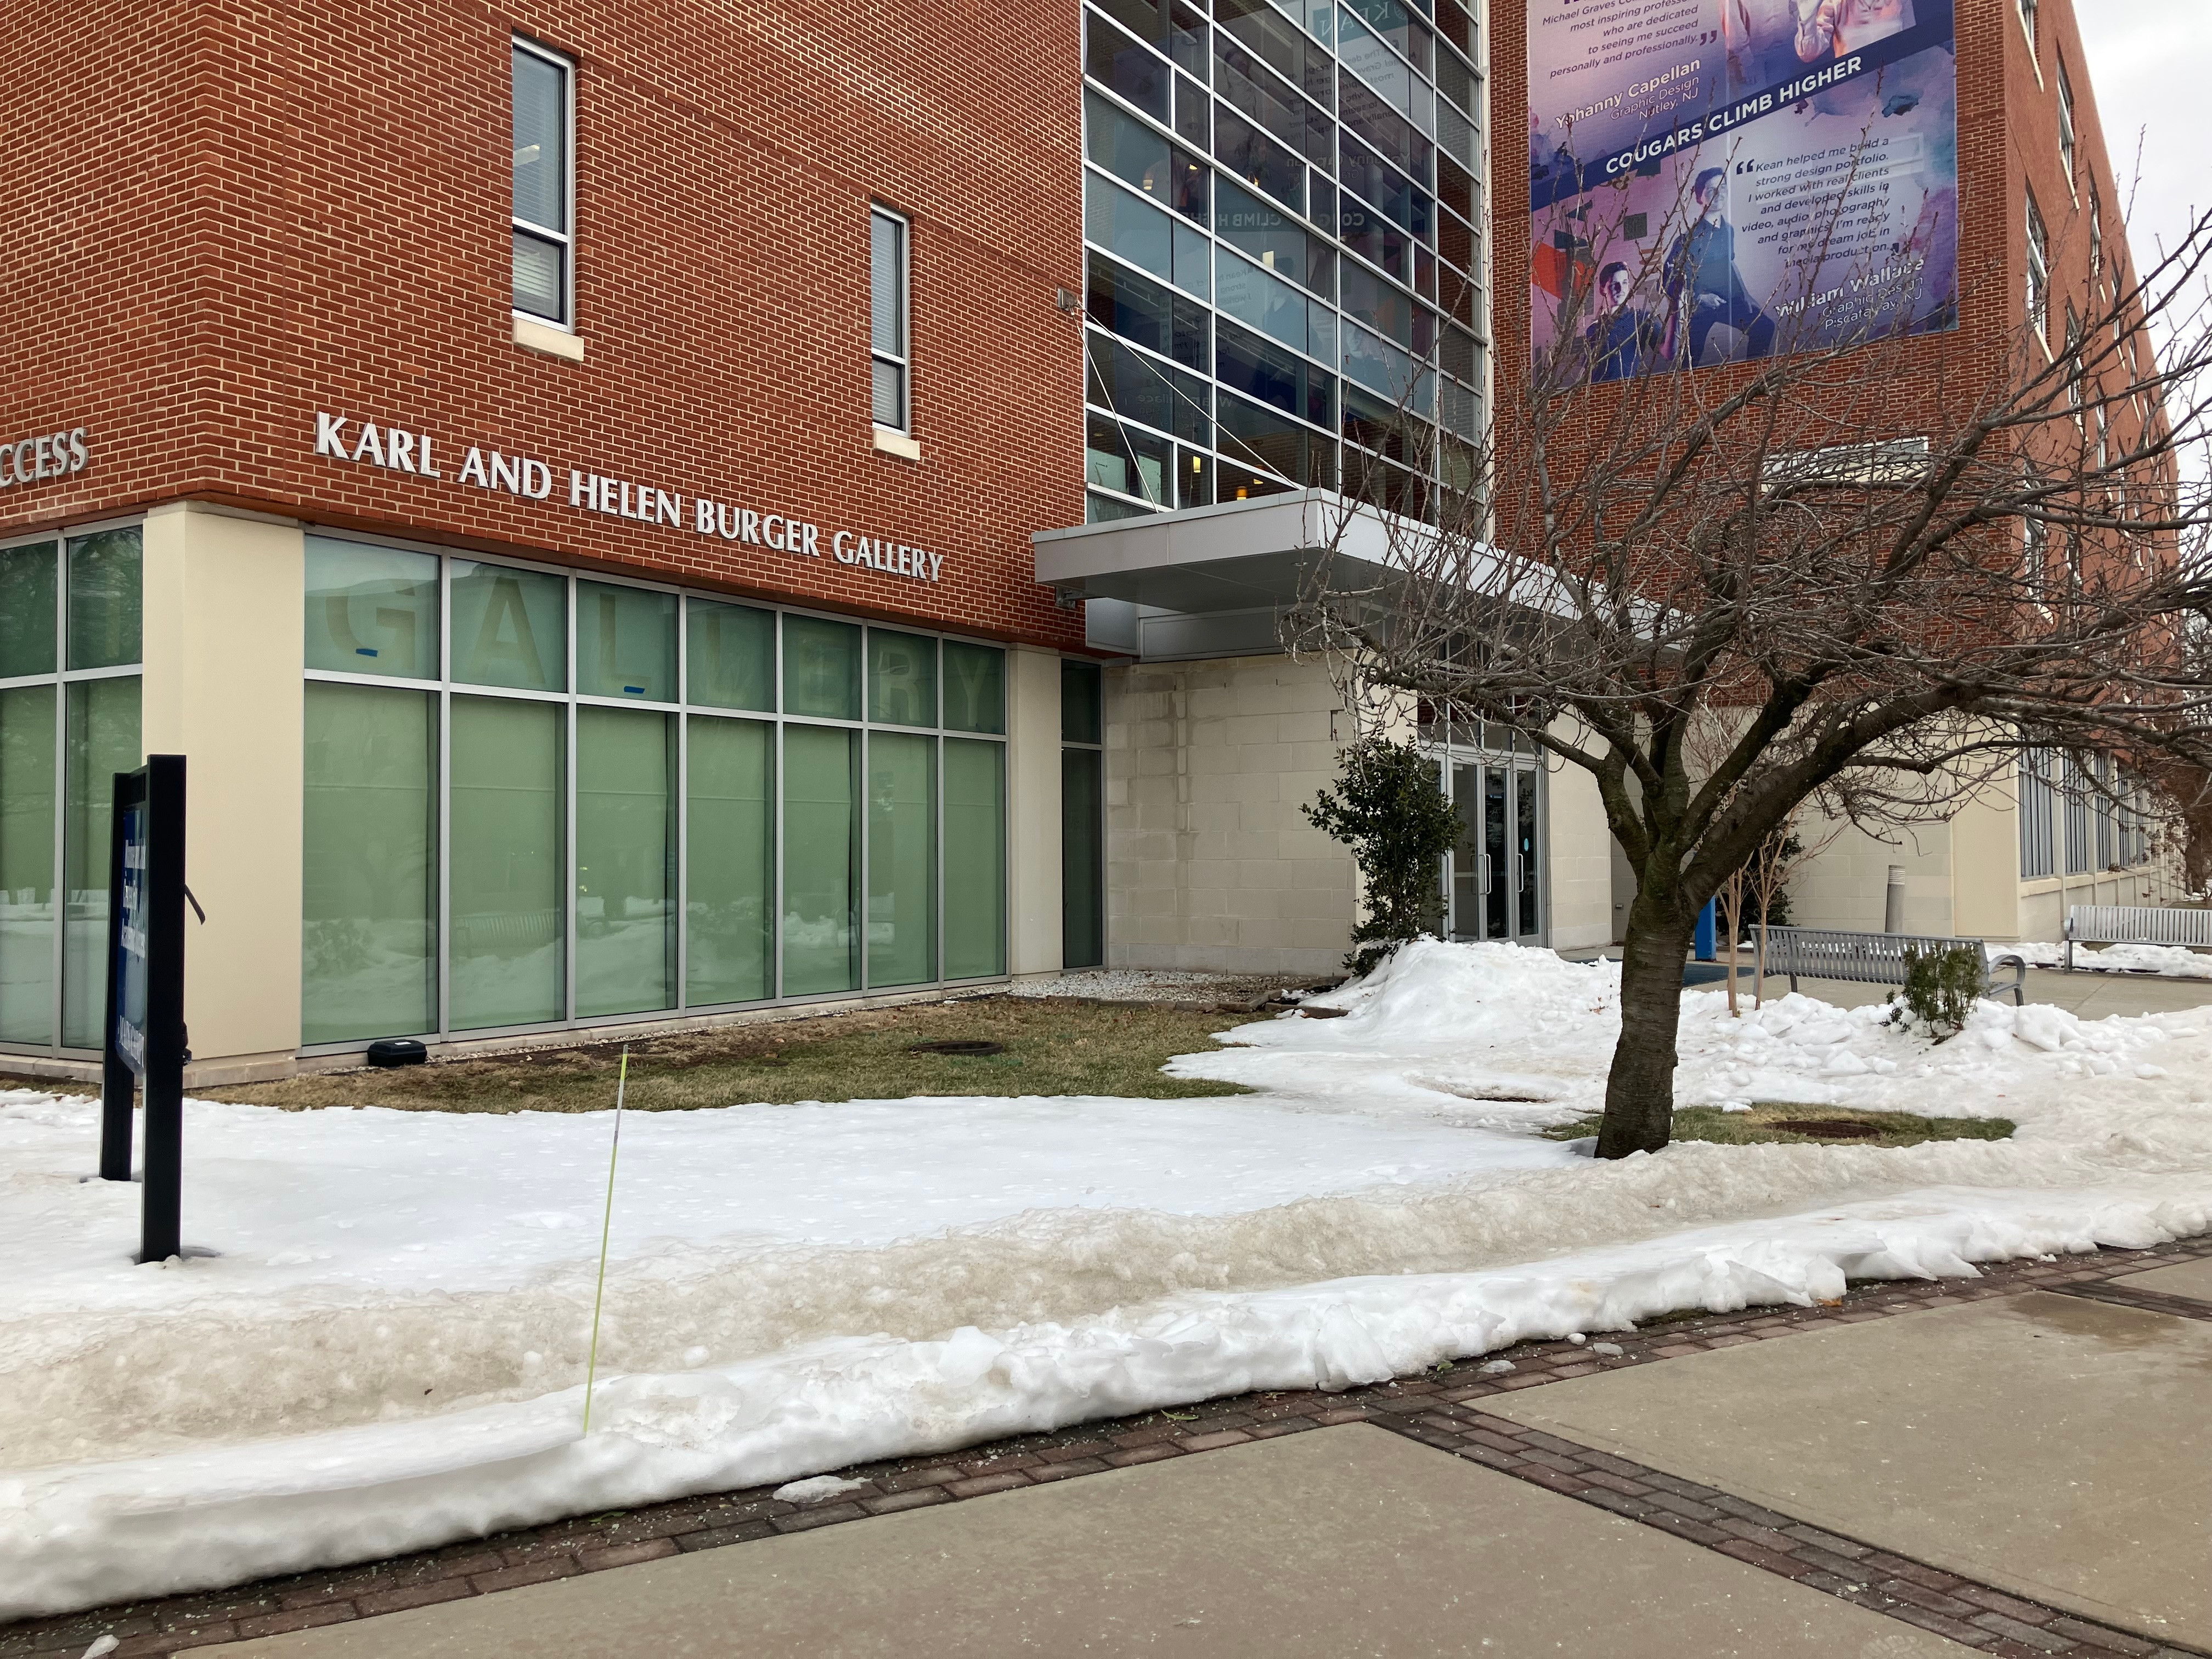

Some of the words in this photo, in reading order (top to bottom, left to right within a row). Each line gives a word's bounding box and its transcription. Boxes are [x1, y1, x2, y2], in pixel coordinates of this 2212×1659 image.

[1542, 9, 1579, 26] Michael
[1582, 1, 1616, 15] Graves
[1570, 20, 1595, 32] most
[1598, 7, 1641, 25] inspiring
[1603, 25, 1624, 37] who
[1627, 20, 1643, 31] are
[1646, 4, 1699, 25] dedicated
[1588, 46, 1599, 54] to
[1601, 37, 1634, 51] seeing
[1637, 32, 1653, 42] me
[1656, 19, 1699, 37] succeed
[1550, 58, 1601, 79] personally
[1603, 53, 1623, 64] and
[1555, 91, 1623, 129] Yohanny
[1627, 59, 1701, 98] Capellan
[1611, 95, 1655, 120] Graphic
[1659, 77, 1700, 100] Design
[1639, 98, 1678, 121] Nutley,
[1682, 88, 1699, 102] NJ
[1605, 123, 1702, 174] COUGARS
[1708, 93, 1773, 132] CLIMB
[1779, 55, 1862, 103] HIGHER
[1786, 149, 1825, 167] helped
[1828, 147, 1846, 157] me
[1882, 138, 1889, 146] a
[1748, 194, 1752, 203] I
[1755, 185, 1796, 201] worked
[1799, 179, 1824, 192] wth
[1826, 174, 1848, 187] real
[1852, 167, 1889, 182] clients
[1756, 172, 1791, 187] strong
[1795, 166, 1832, 180] design
[1760, 203, 1781, 215] and
[1785, 189, 1846, 210] developed
[1847, 184, 1875, 198] skills
[1879, 182, 1889, 190] in
[1742, 221, 1774, 233] video,
[1815, 198, 1890, 220] phoography
[1758, 232, 1778, 244] and
[1836, 219, 1853, 229] I'm
[1778, 245, 1794, 255] for
[1818, 234, 1854, 247] deam
[1880, 227, 1889, 236] in
[1774, 286, 1844, 317] Wiliam
[1878, 277, 1923, 300] Desgn
[316, 410, 441, 479] KARL
[456, 445, 552, 500] AND
[568, 468, 681, 529] HELEN
[695, 496, 821, 558] BURGER
[831, 529, 944, 583] GALLERY
[326, 573, 1000, 726] GALLERY
